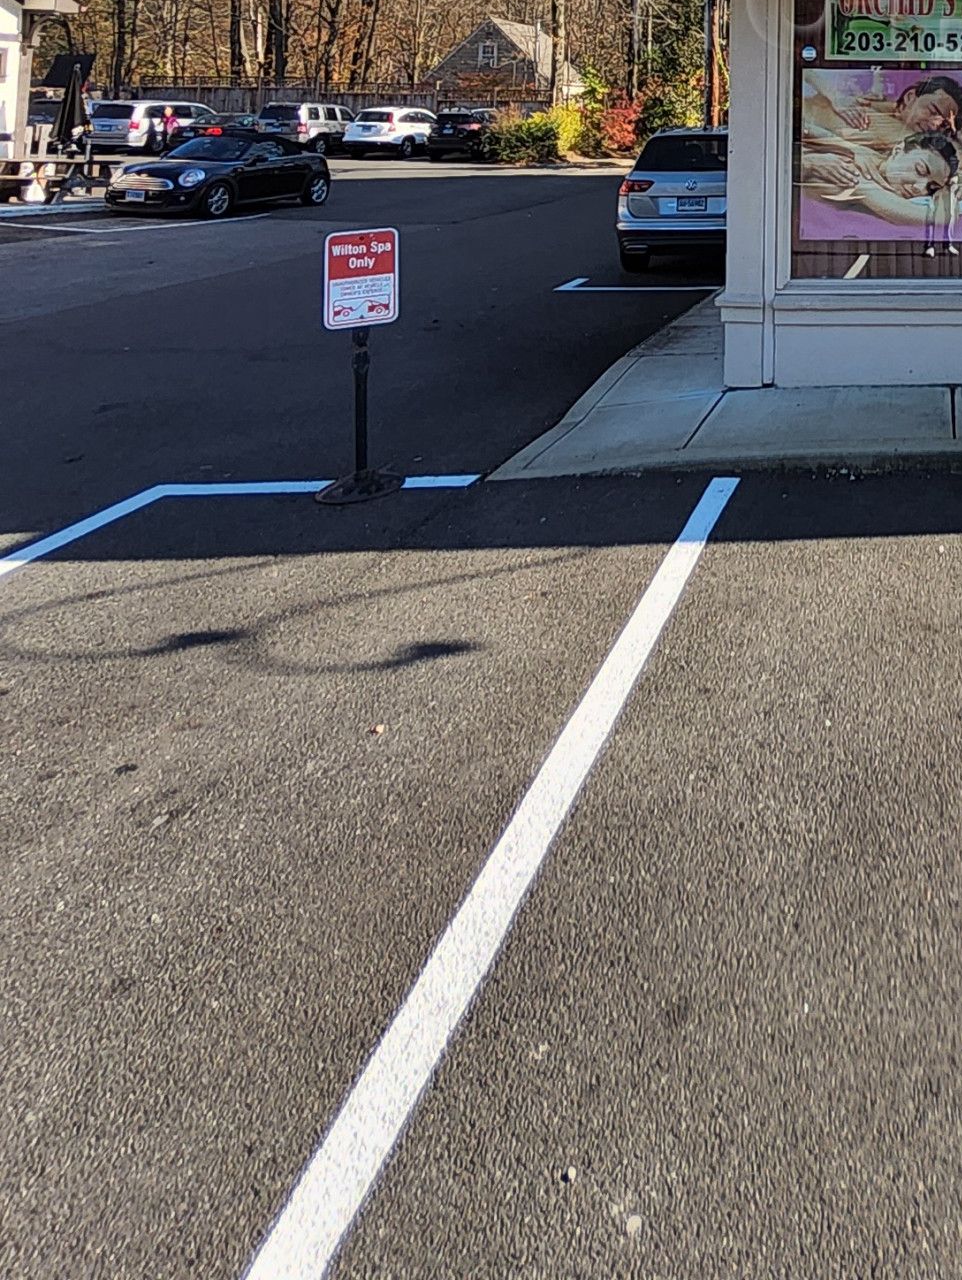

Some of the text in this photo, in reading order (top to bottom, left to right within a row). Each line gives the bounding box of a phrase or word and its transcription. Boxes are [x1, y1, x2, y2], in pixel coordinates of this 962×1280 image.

[331, 241, 392, 257] Wilton Spa
[349, 256, 376, 269] Only
